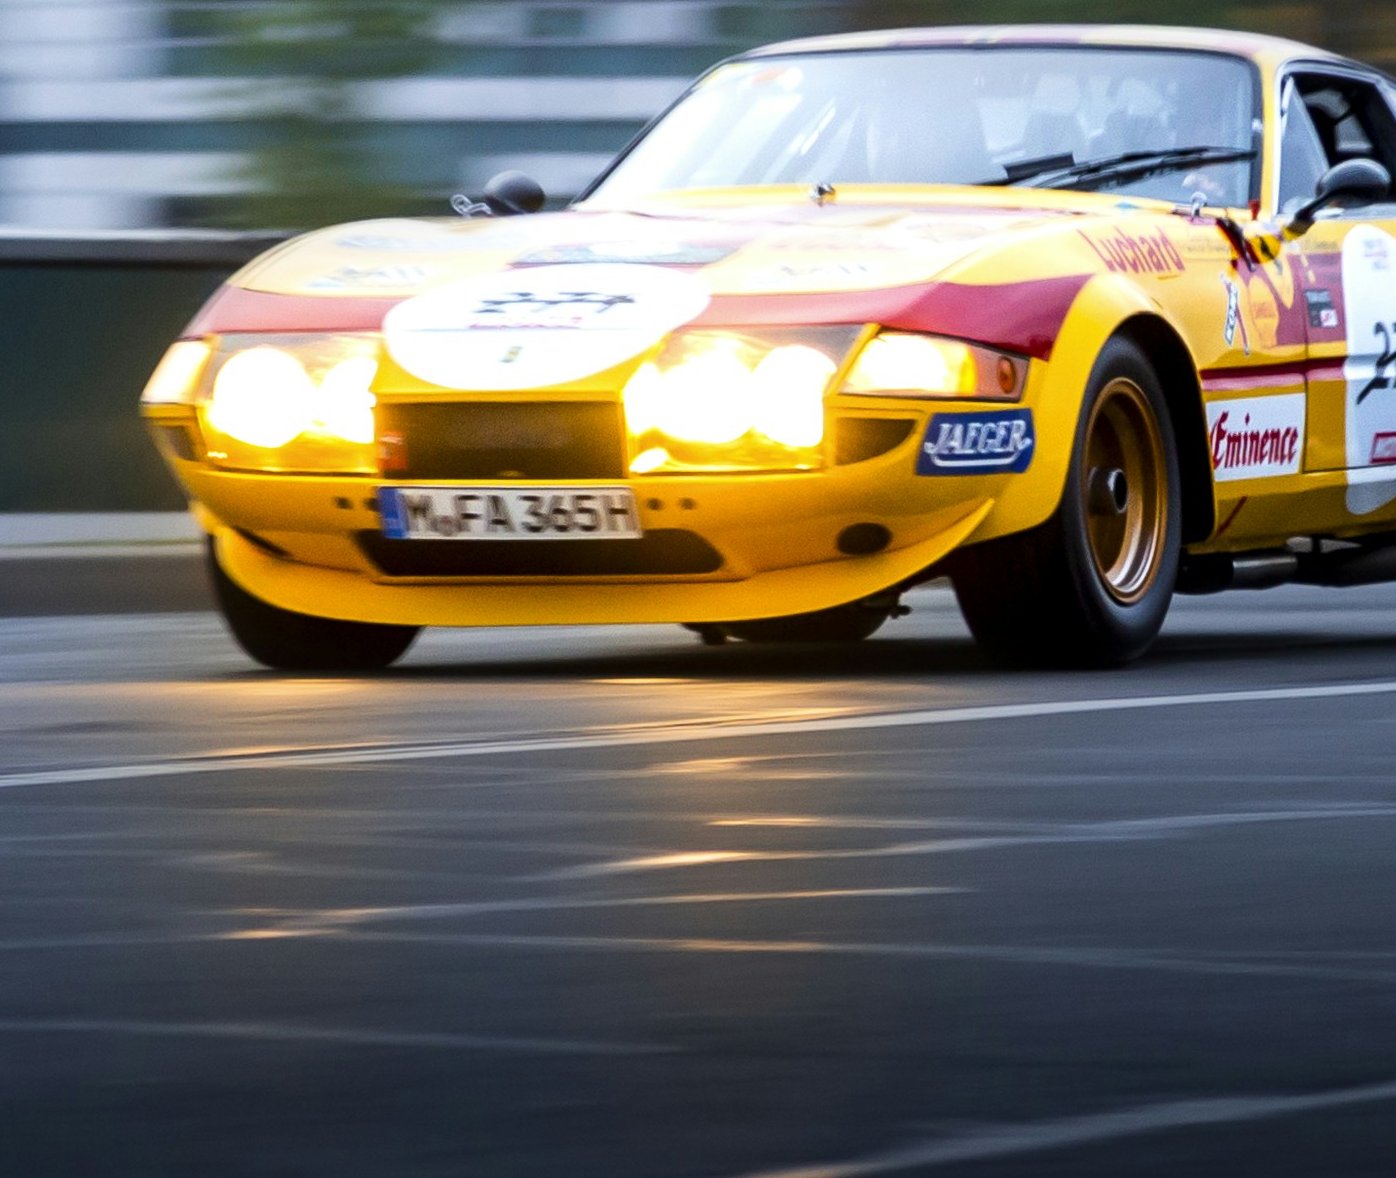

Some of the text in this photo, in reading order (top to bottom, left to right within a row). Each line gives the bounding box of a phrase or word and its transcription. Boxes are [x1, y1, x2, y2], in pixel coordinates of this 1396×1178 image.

[1076, 225, 1185, 274] Luchard
[924, 420, 1032, 454] JAEGER
[1210, 410, 1298, 470] Eminence
[403, 494, 639, 533] M FA 365H
